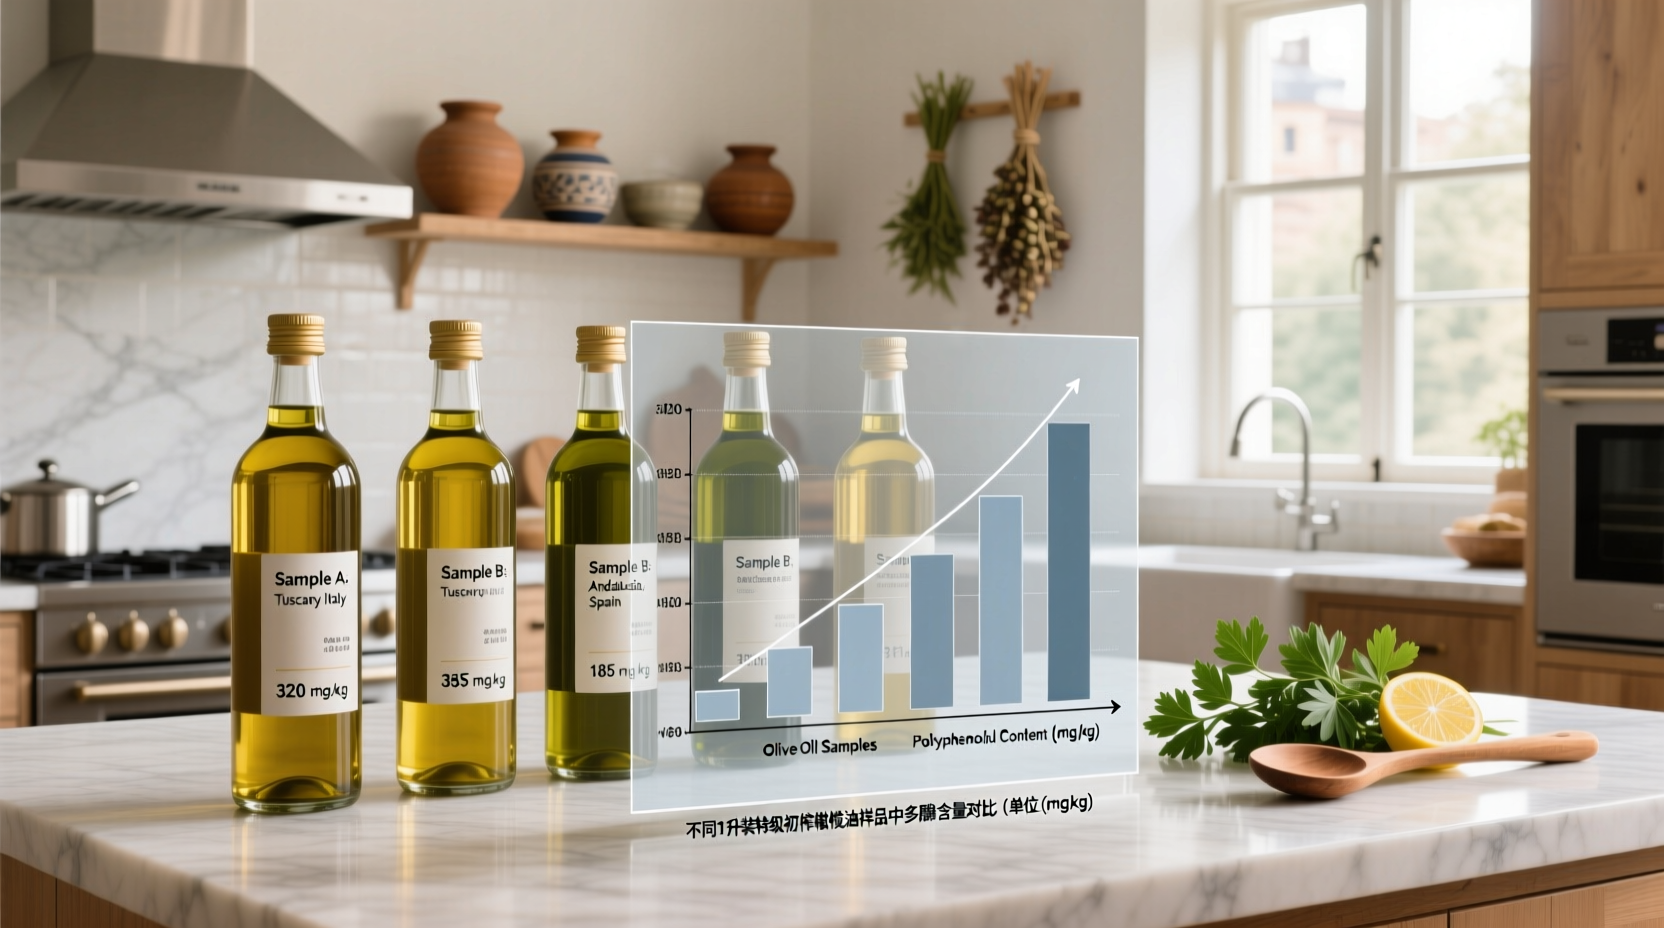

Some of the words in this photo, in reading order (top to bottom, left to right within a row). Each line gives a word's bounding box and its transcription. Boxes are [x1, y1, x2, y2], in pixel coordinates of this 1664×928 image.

[589, 560, 638, 576] Sample
[736, 555, 780, 571] Sample
[275, 570, 332, 589] Sample
[441, 564, 492, 582] Sample
[324, 592, 347, 608] Italy
[589, 596, 622, 611] Spain
[590, 663, 616, 678] 185
[276, 683, 306, 698] 320
[310, 682, 348, 700] mg/kg
